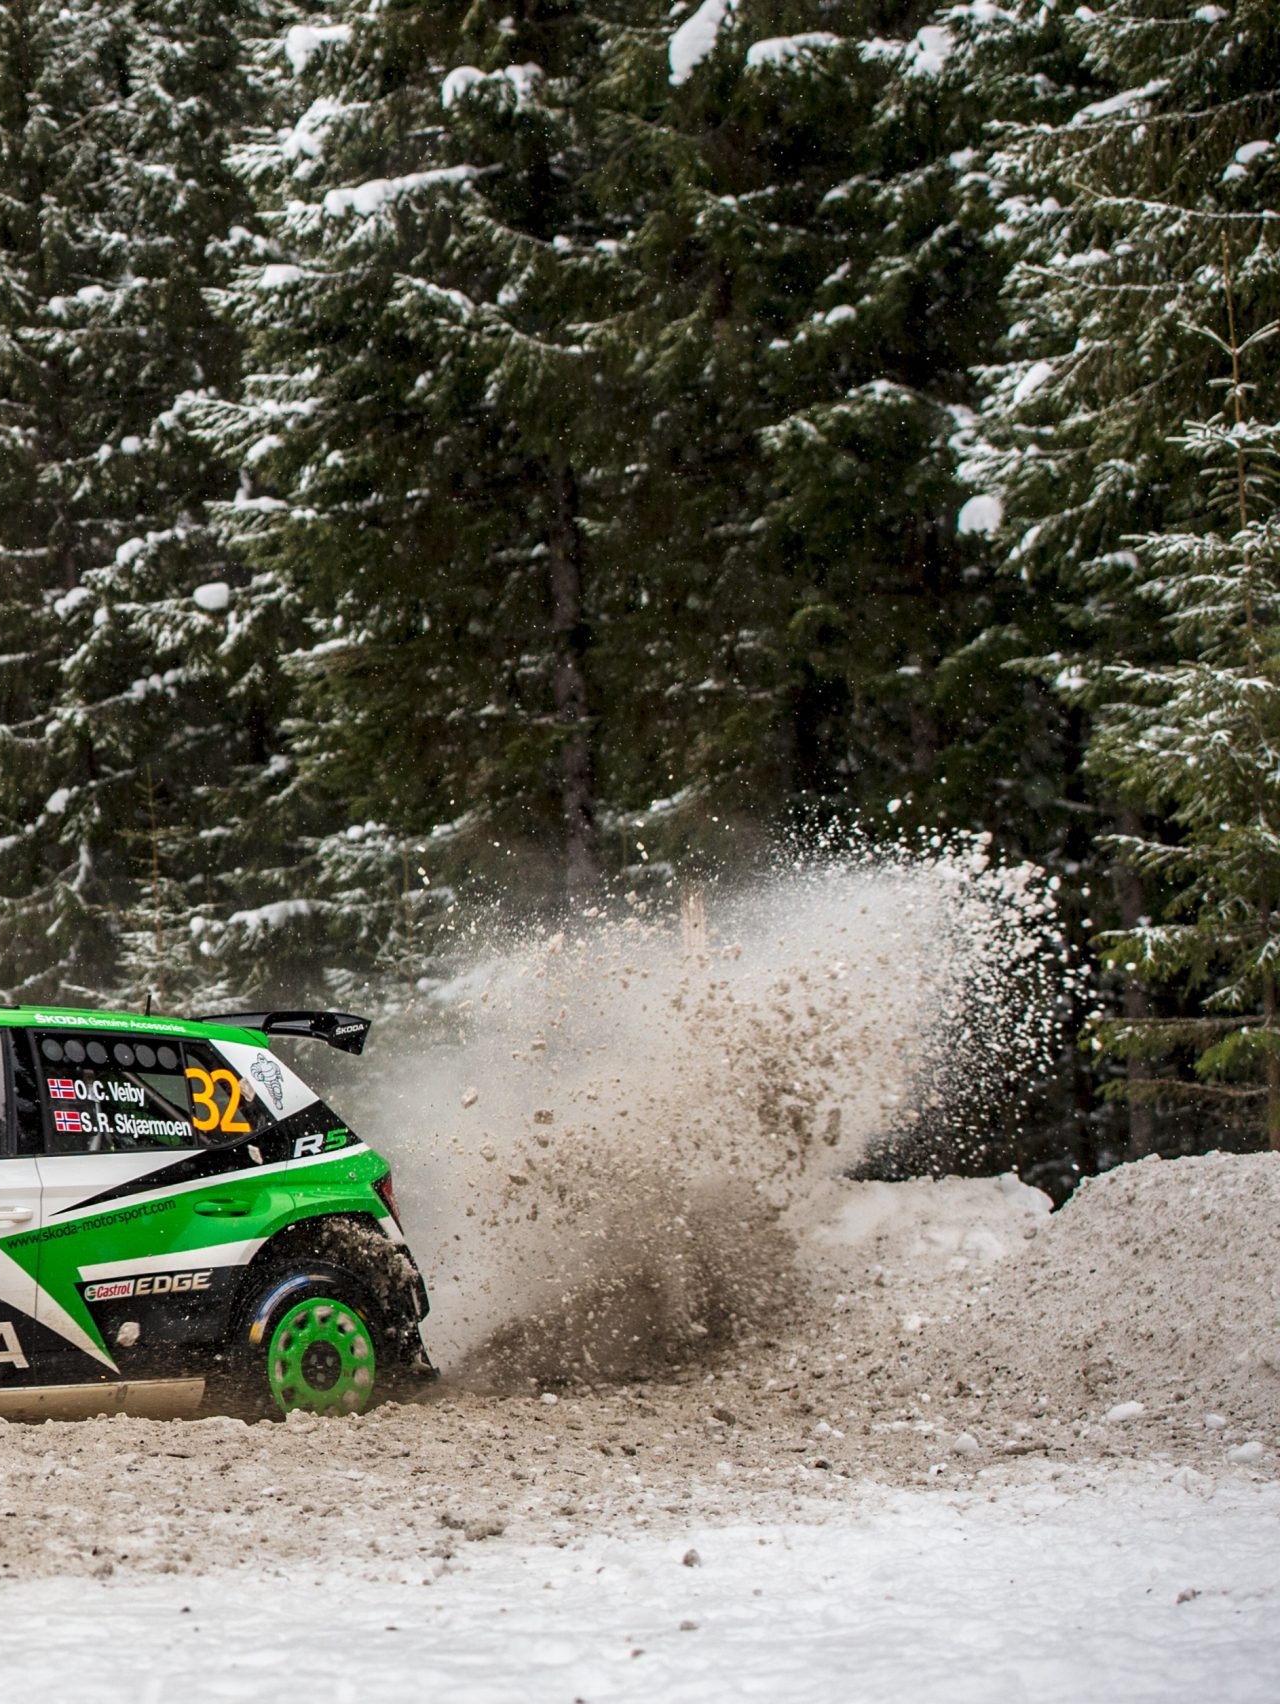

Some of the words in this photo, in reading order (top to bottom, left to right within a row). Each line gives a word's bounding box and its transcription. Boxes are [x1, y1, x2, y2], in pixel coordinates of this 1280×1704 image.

[34, 1013, 89, 1026] ŠKODA
[88, 1017, 129, 1029] Genuine
[130, 1020, 186, 1033] Accessories
[335, 1023, 365, 1035] ŠKODA
[107, 1081, 145, 1107] Veiby
[185, 1067, 251, 1133] 32
[114, 1112, 193, 1139] Skjærmoen
[294, 1128, 349, 1158] R5
[6, 1199, 177, 1250] www.skoda-motorsport.com
[95, 1284, 132, 1299] Castrol
[133, 1270, 213, 1297] EDGE
